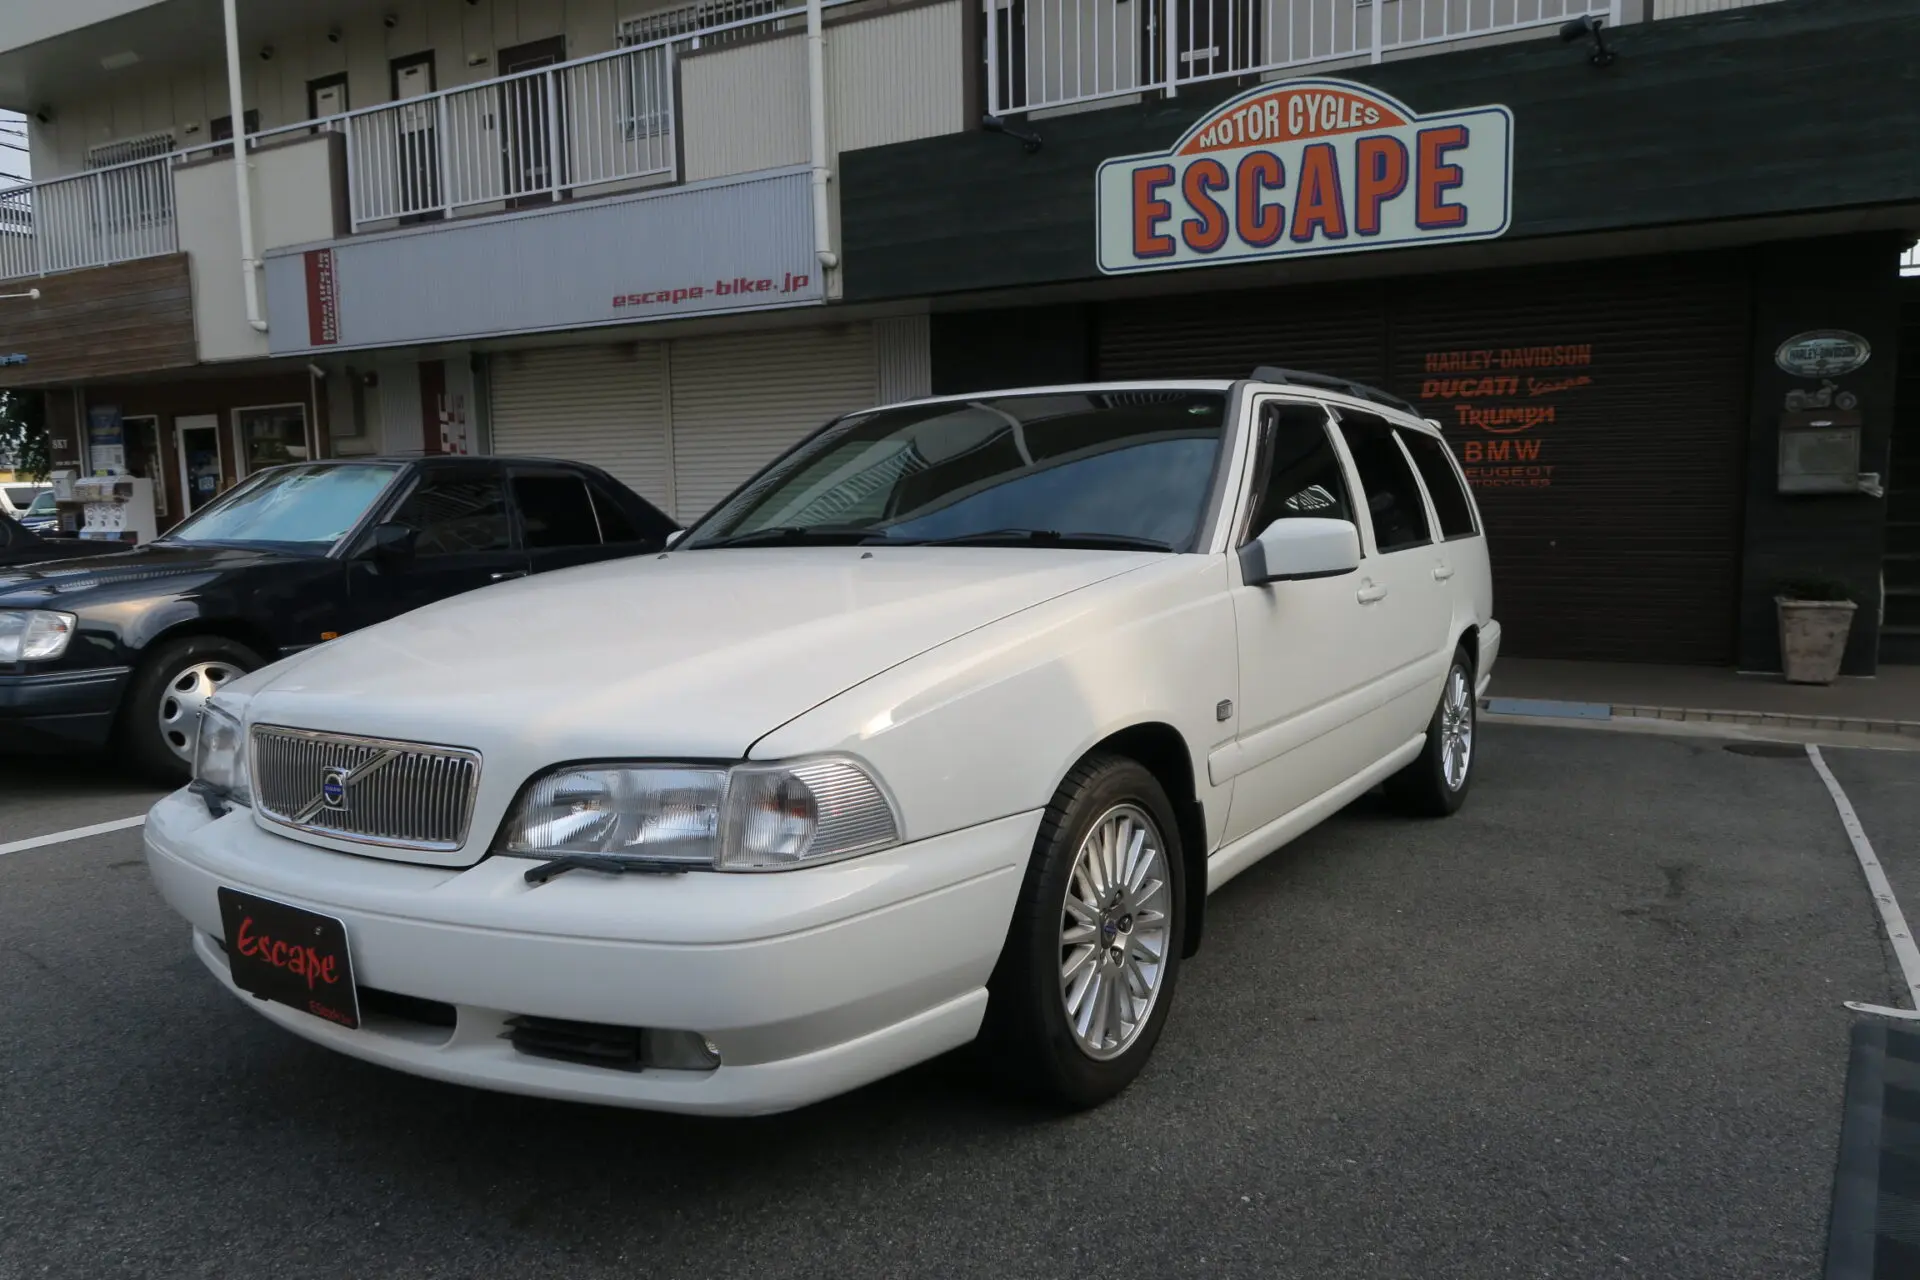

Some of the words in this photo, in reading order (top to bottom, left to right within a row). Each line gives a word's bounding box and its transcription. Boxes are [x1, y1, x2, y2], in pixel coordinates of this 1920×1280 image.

[1199, 97, 1280, 149] MOTOR
[1288, 93, 1381, 135] CYCLES
[1131, 124, 1470, 259] ESCAPE
[612, 272, 810, 308] escape-bike.jp
[1425, 344, 1592, 373] HARLEY-DAVIDSON
[1420, 376, 1519, 399] DUCATI
[1464, 439, 1542, 462] BMW
[1464, 466, 1555, 478] EUGEOT
[237, 915, 339, 991] Escape
